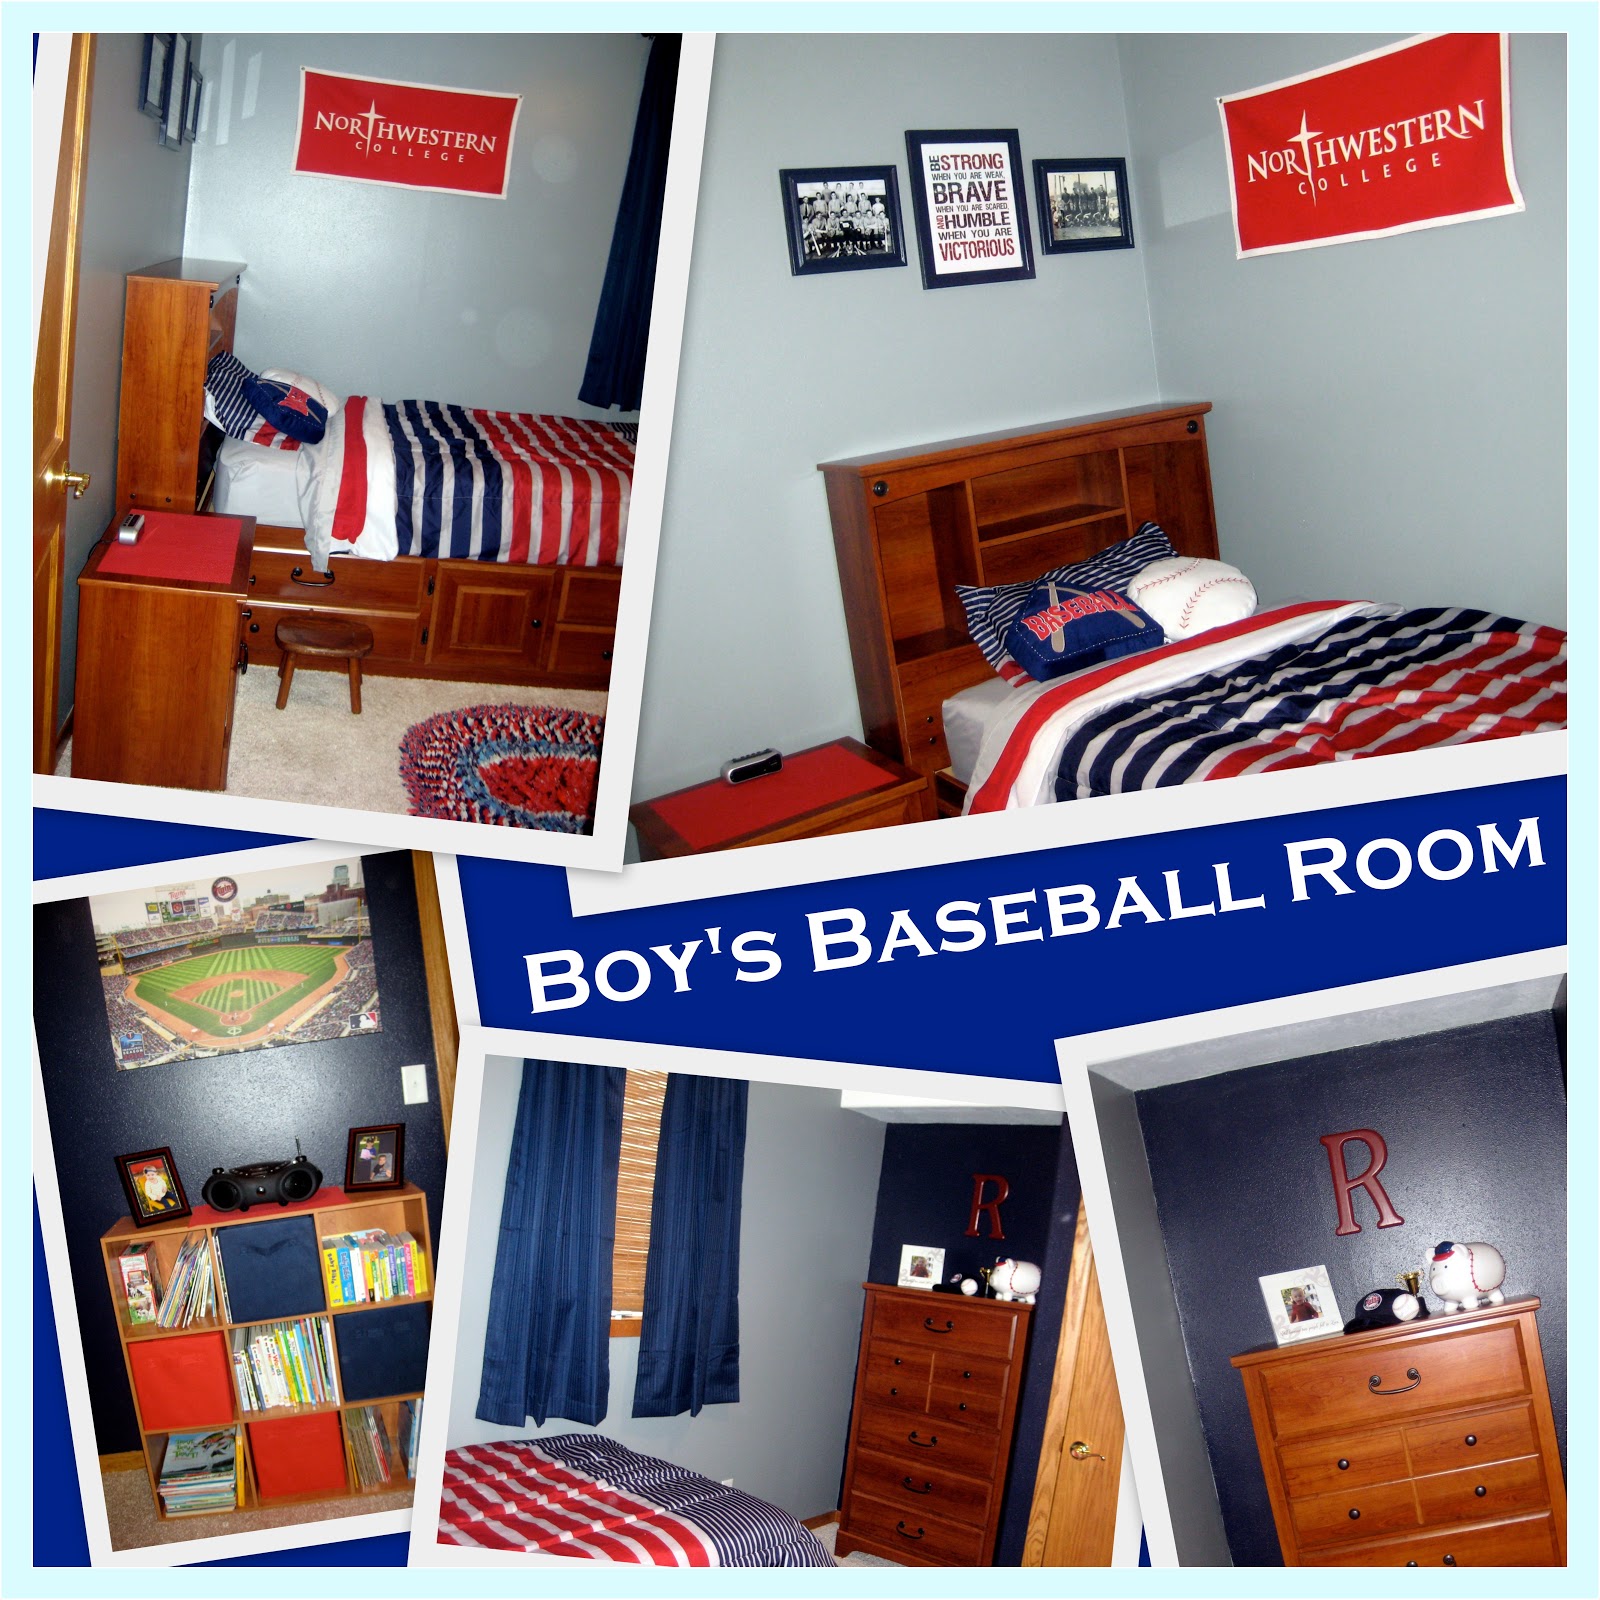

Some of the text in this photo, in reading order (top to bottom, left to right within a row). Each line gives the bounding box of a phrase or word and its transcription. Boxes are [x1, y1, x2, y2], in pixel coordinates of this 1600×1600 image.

[314, 99, 497, 158] NORTHWESTERN
[355, 141, 464, 162] COLLEGE
[929, 153, 1004, 171] BE STRONG
[1247, 99, 1486, 206] NORTHWESTERN
[932, 172, 951, 181] WHEN
[954, 172, 967, 180] YOU
[970, 171, 982, 179] ARE
[1298, 152, 1441, 194] COLLEGE
[932, 180, 1008, 204] BRAVE
[936, 205, 954, 213] WHEN
[956, 204, 969, 212] YOU
[936, 211, 1011, 230] AND HUMBLE
[938, 227, 1013, 241] WHEN YOU ARE
[939, 237, 1015, 261] VICTORIOUS
[1021, 589, 1140, 641] BASEBALL
[1319, 1128, 1405, 1236] R
[964, 1173, 1010, 1240] R
